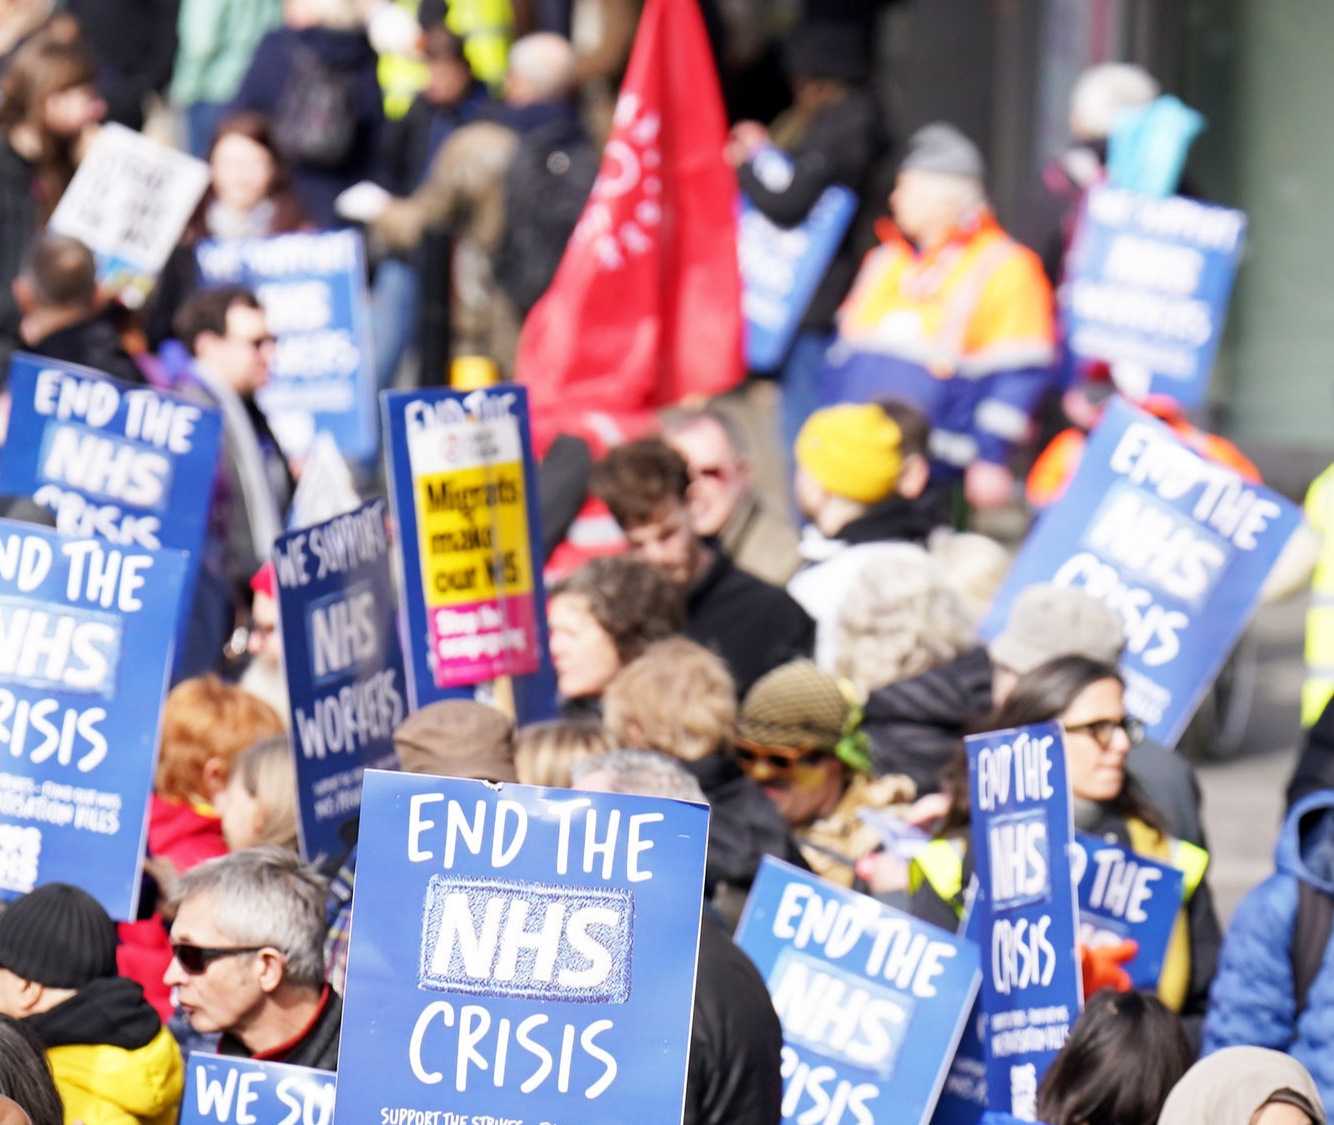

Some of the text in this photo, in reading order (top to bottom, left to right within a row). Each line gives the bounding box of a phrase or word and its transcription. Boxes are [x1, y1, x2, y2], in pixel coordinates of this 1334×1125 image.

[34, 369, 202, 454] END THE
[44, 425, 171, 509] NHS
[61, 540, 154, 612] THE
[1089, 493, 1226, 599] NHS
[311, 592, 374, 678] NHS
[296, 667, 405, 760] WORKERS
[977, 733, 1055, 809] END THE
[407, 792, 665, 882] END THE
[988, 822, 1047, 901] NHS
[1088, 847, 1164, 924] THE
[431, 892, 619, 989] NHS
[772, 882, 958, 999] END THE
[991, 915, 1057, 995] CRISIS
[408, 1000, 618, 1100] CRISIS
[772, 958, 909, 1066] NHS
